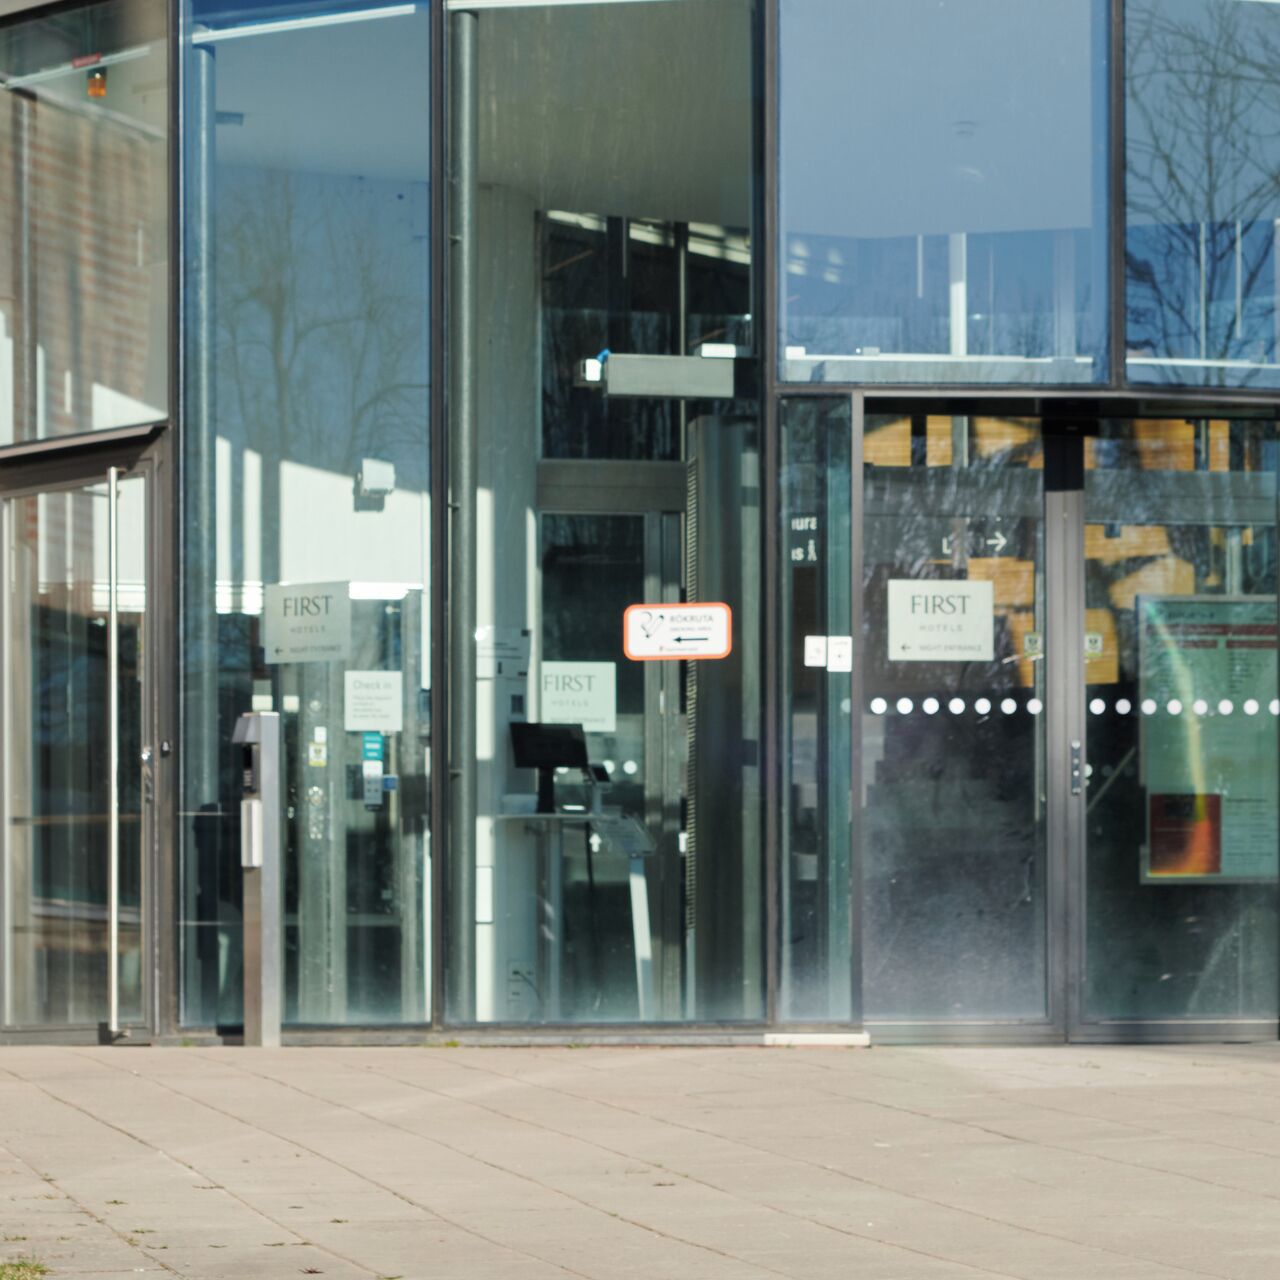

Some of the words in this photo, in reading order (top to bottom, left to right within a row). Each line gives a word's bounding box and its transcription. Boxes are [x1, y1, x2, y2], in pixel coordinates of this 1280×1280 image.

[283, 594, 333, 617] FIRST
[910, 595, 971, 615] FIRST
[919, 623, 963, 633] HOTELS
[543, 674, 596, 692] FIRST
